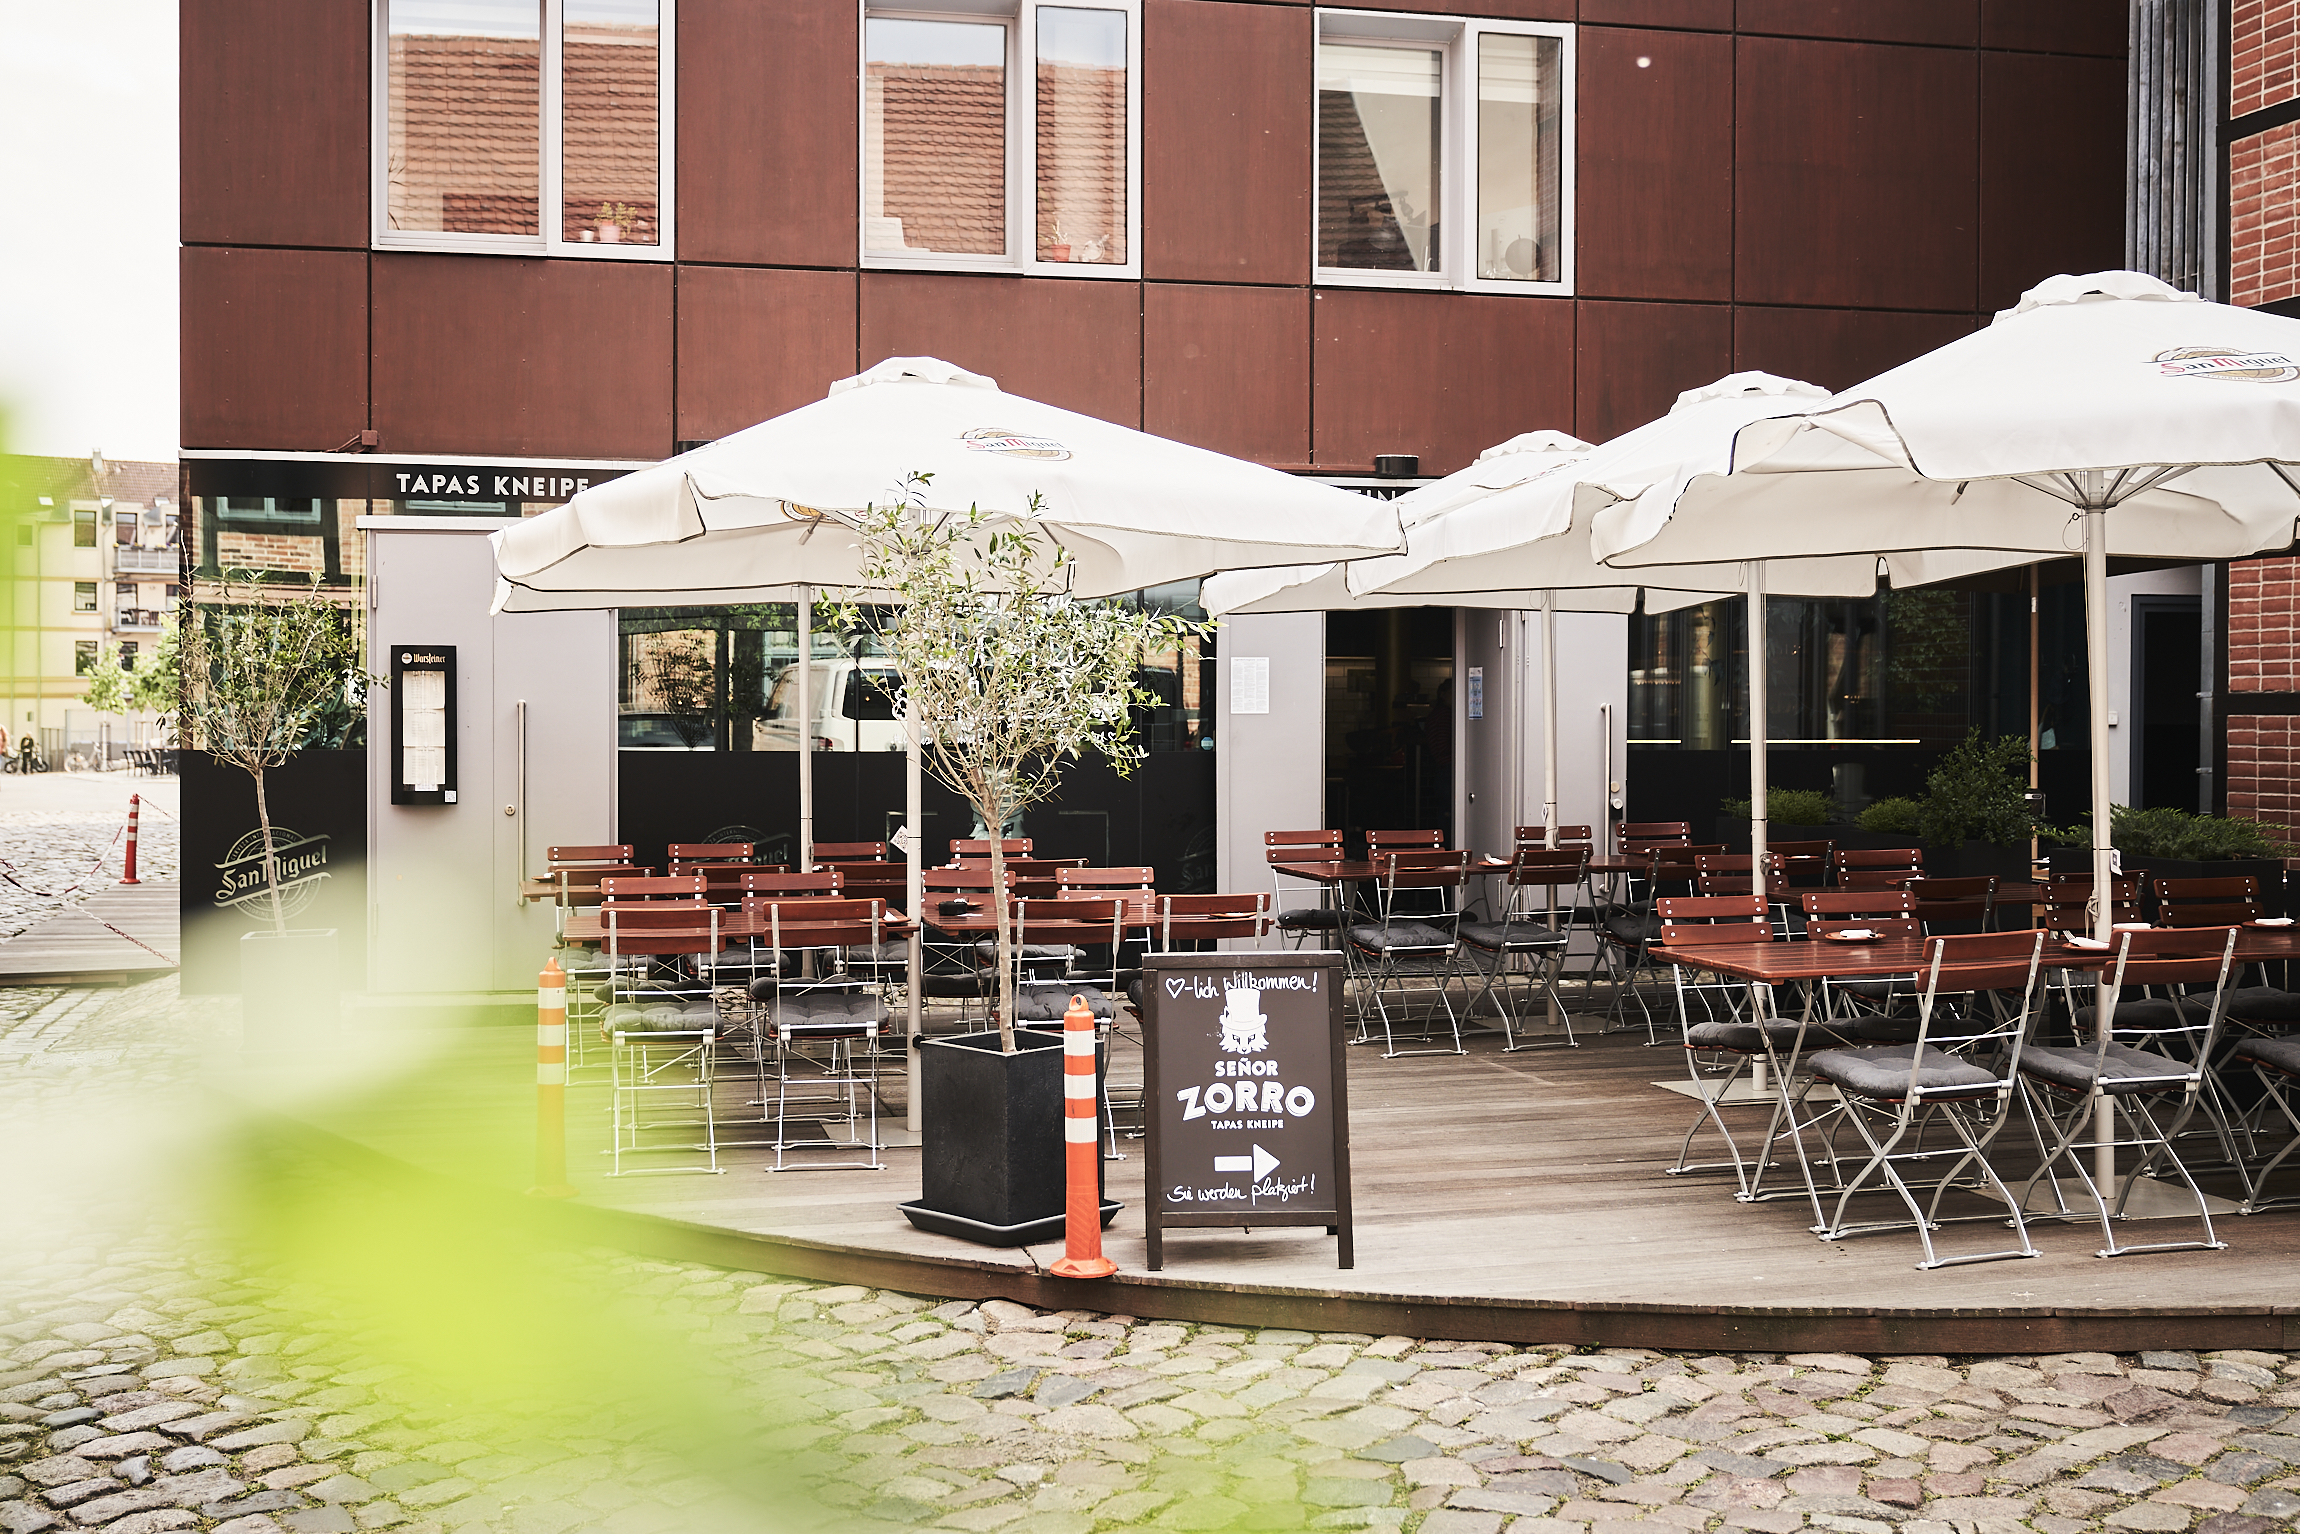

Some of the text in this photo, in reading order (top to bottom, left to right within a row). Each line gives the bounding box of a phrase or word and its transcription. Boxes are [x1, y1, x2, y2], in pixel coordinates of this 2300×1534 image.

[396, 473, 480, 495] TAPAS
[249, 830, 298, 842] INTEACIONAL
[1215, 1058, 1278, 1077] SEÑOR
[1176, 1080, 1316, 1121] ZORRO
[1211, 1119, 1284, 1130] TAPAS KNEIPE
[1167, 1173, 1316, 1206] Sie werden platziert!
